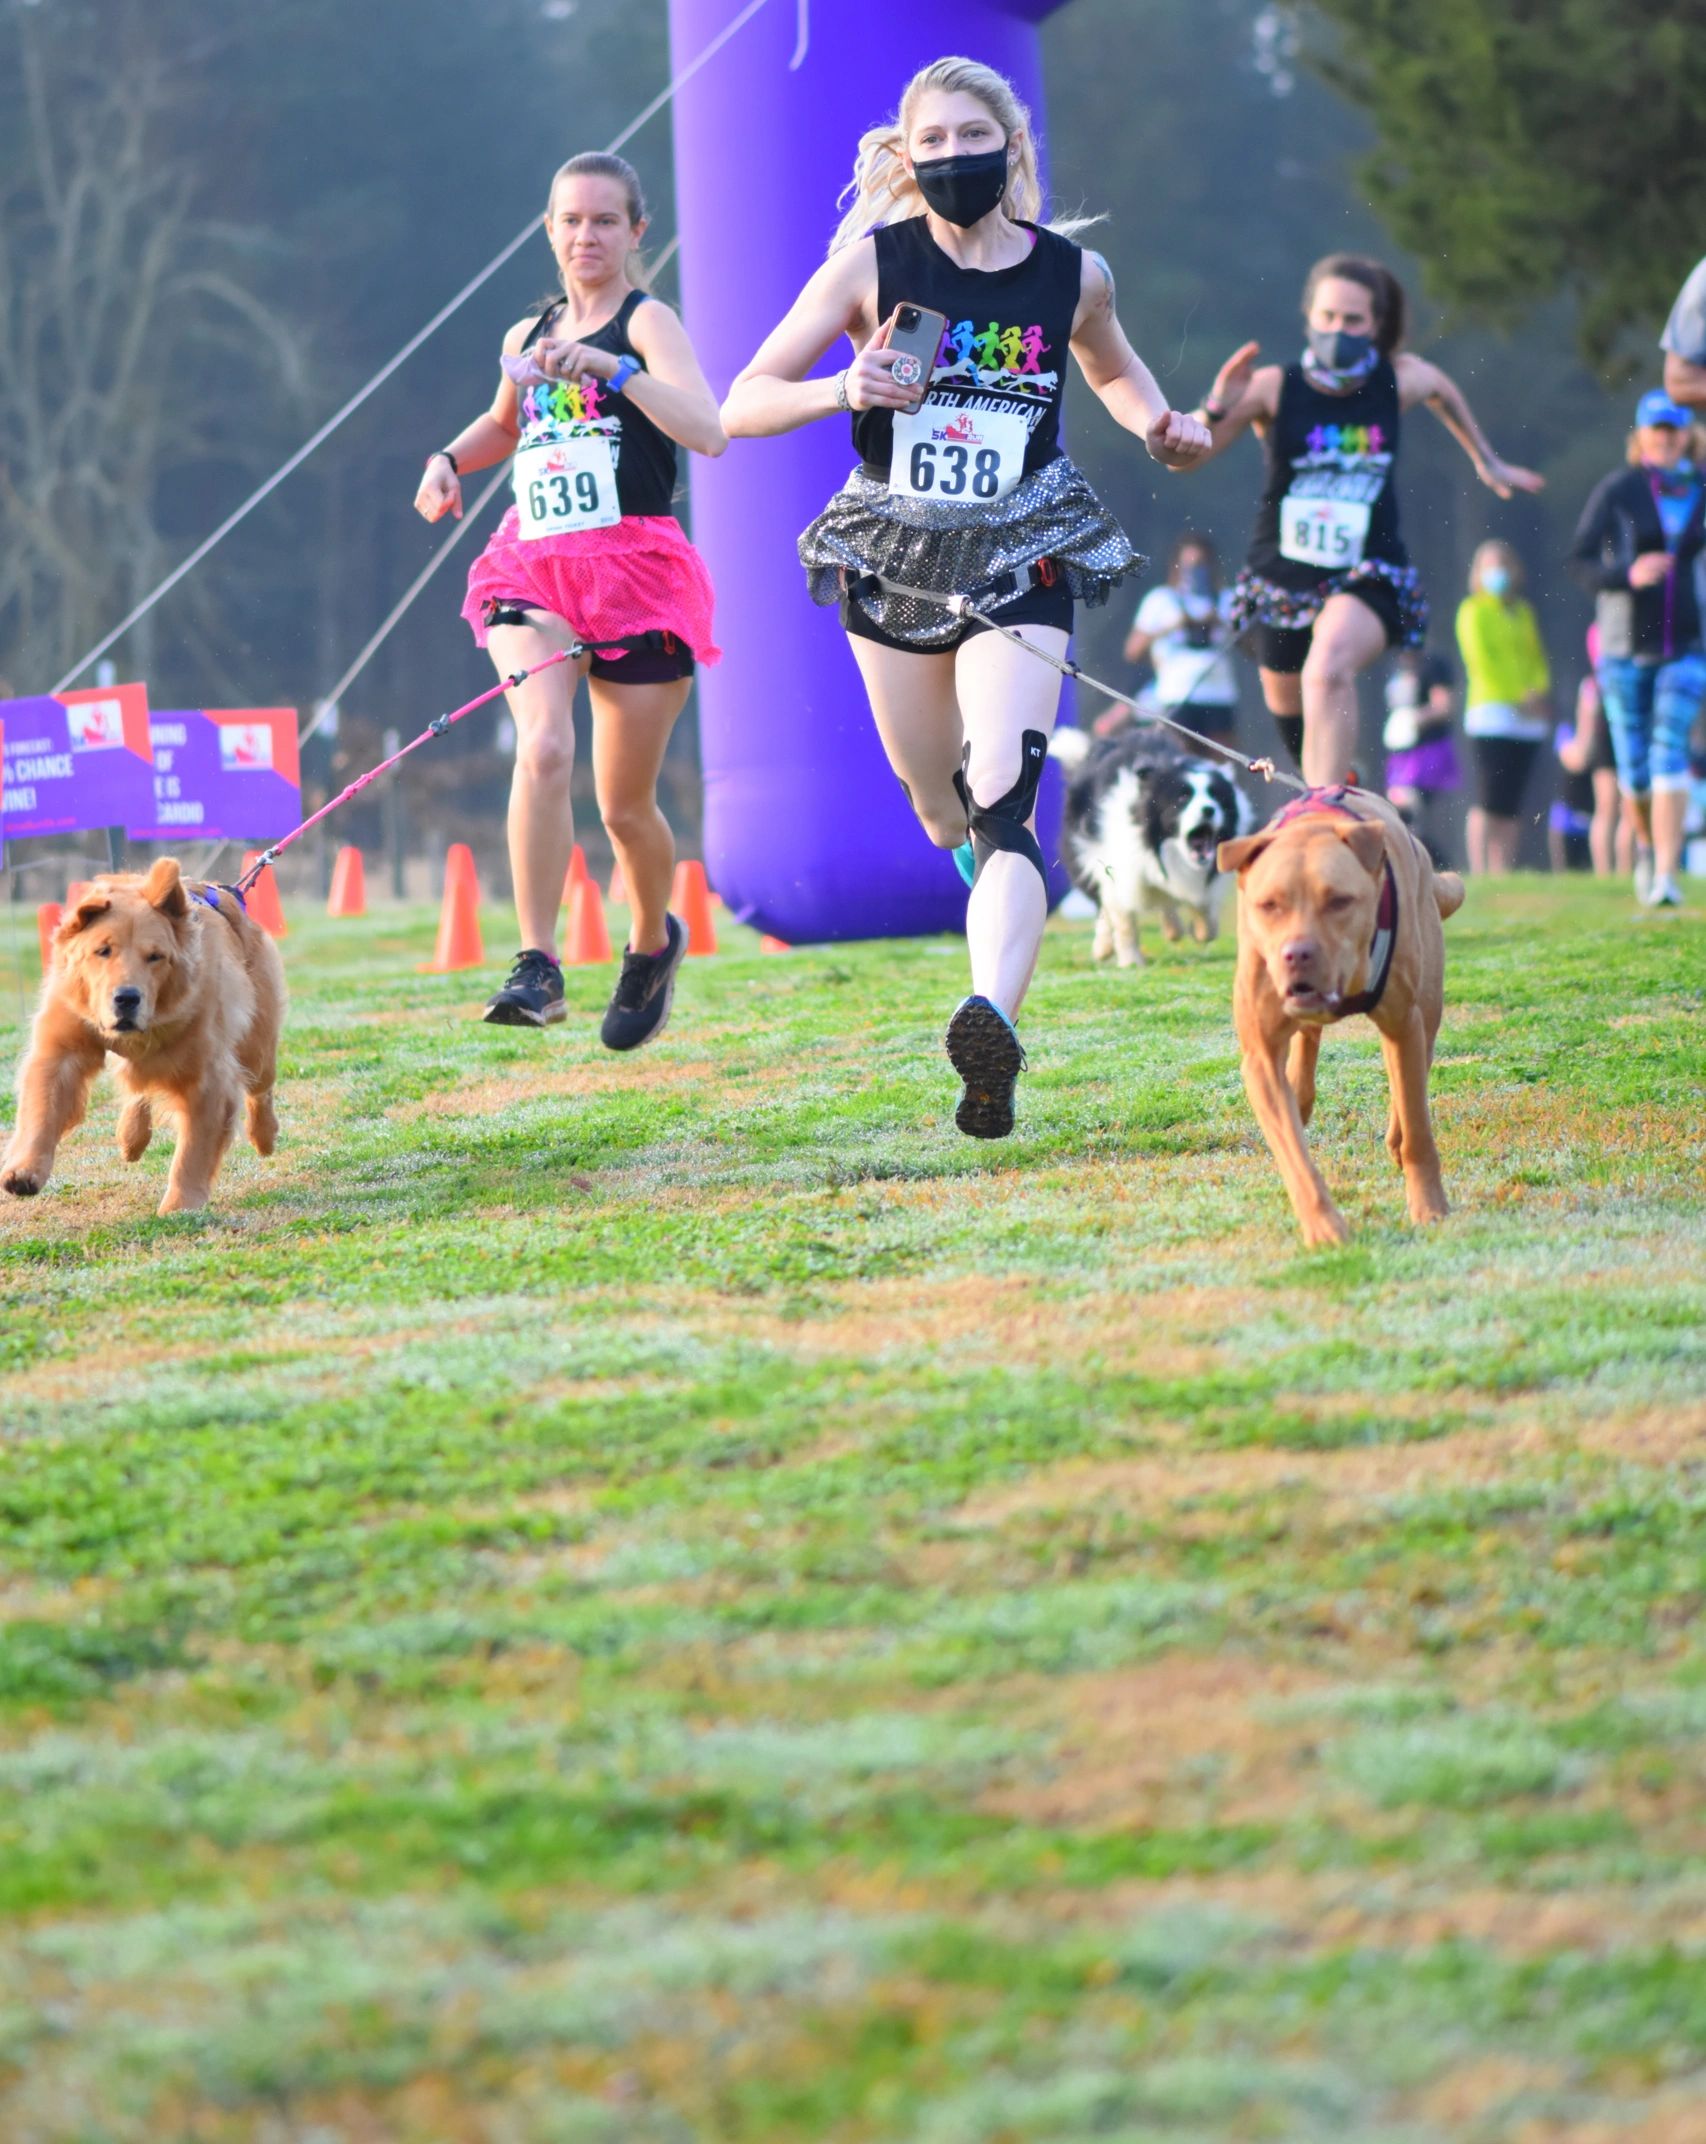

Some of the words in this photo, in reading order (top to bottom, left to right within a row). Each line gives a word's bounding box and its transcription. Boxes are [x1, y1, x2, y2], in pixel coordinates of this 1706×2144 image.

[925, 390, 961, 408] RTH
[962, 394, 1047, 426] AMERICAN
[931, 428, 947, 441] 5K
[910, 442, 1001, 498] 638
[528, 471, 599, 521] 639
[1296, 521, 1349, 553] 815
[16, 753, 75, 782] CHANCE
[1030, 746, 1041, 758] KT
